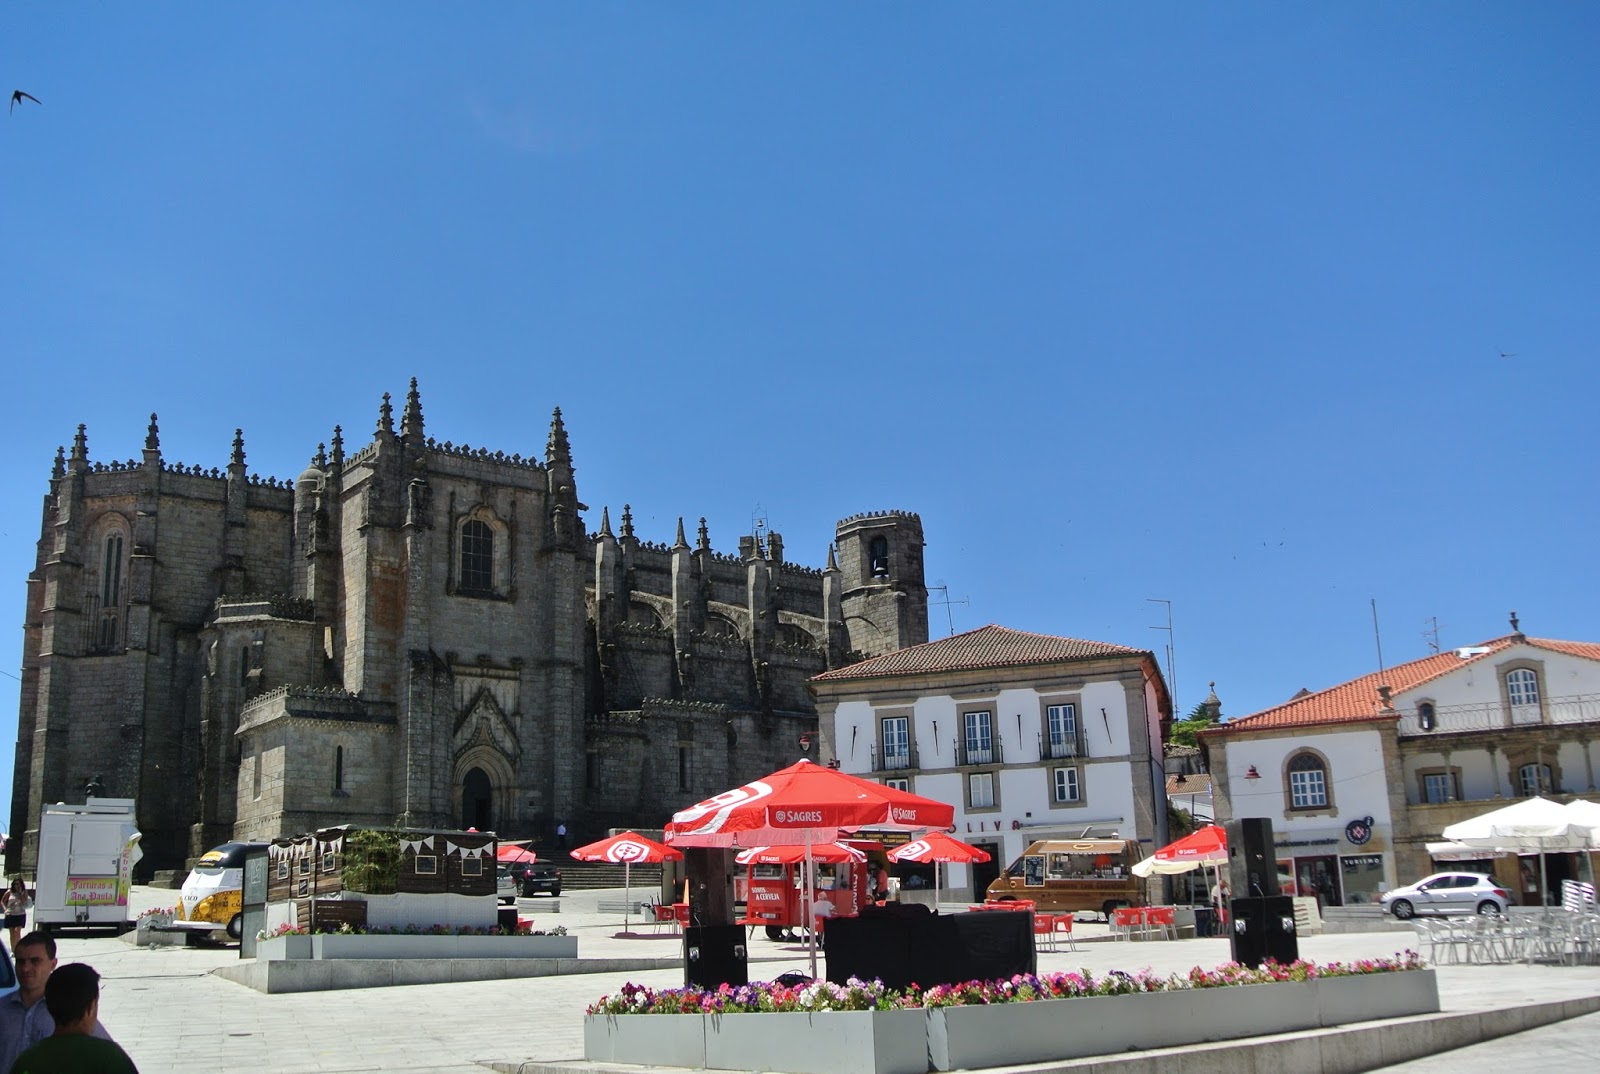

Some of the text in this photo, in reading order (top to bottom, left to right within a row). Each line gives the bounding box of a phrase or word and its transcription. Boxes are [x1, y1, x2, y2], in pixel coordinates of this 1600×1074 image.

[787, 811, 822, 822] SAGRES
[898, 808, 916, 820] SAGRES
[71, 891, 113, 902] Ana Paula
